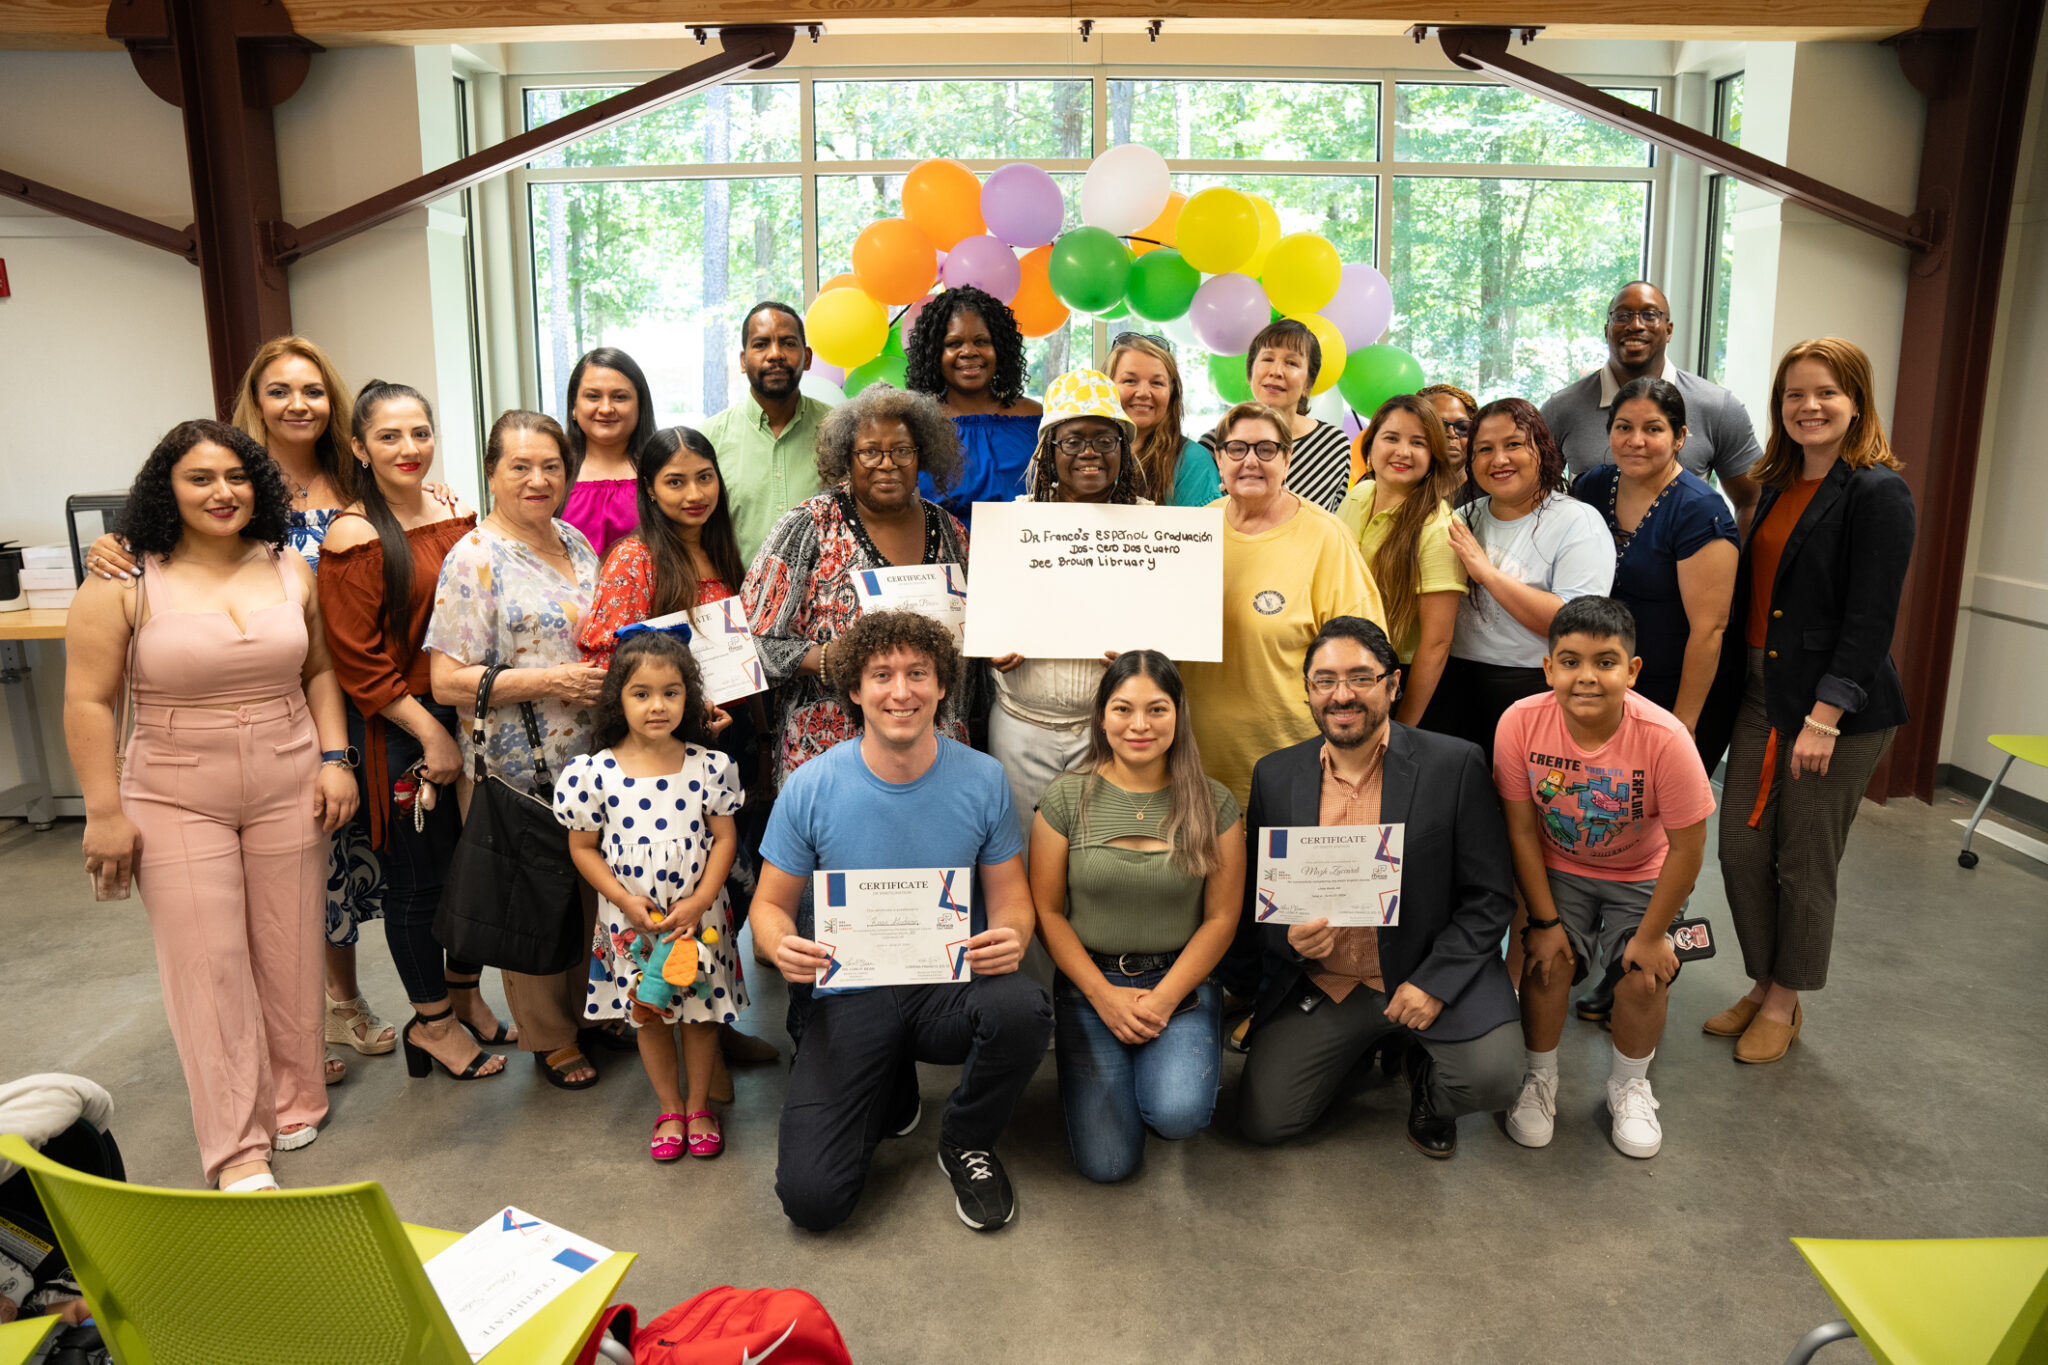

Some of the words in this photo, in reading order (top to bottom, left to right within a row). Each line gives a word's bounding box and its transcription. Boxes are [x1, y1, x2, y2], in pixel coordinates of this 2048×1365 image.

[1096, 543, 1119, 553] Cero
[1144, 544, 1181, 554] Cuatro
[886, 573, 937, 583] CERTIFICATE
[1530, 752, 1582, 772] CREATE
[1631, 769, 1645, 822] EXPLORE
[1300, 835, 1367, 845] CERTIFICATE
[858, 880, 929, 891] CERTIFICATE
